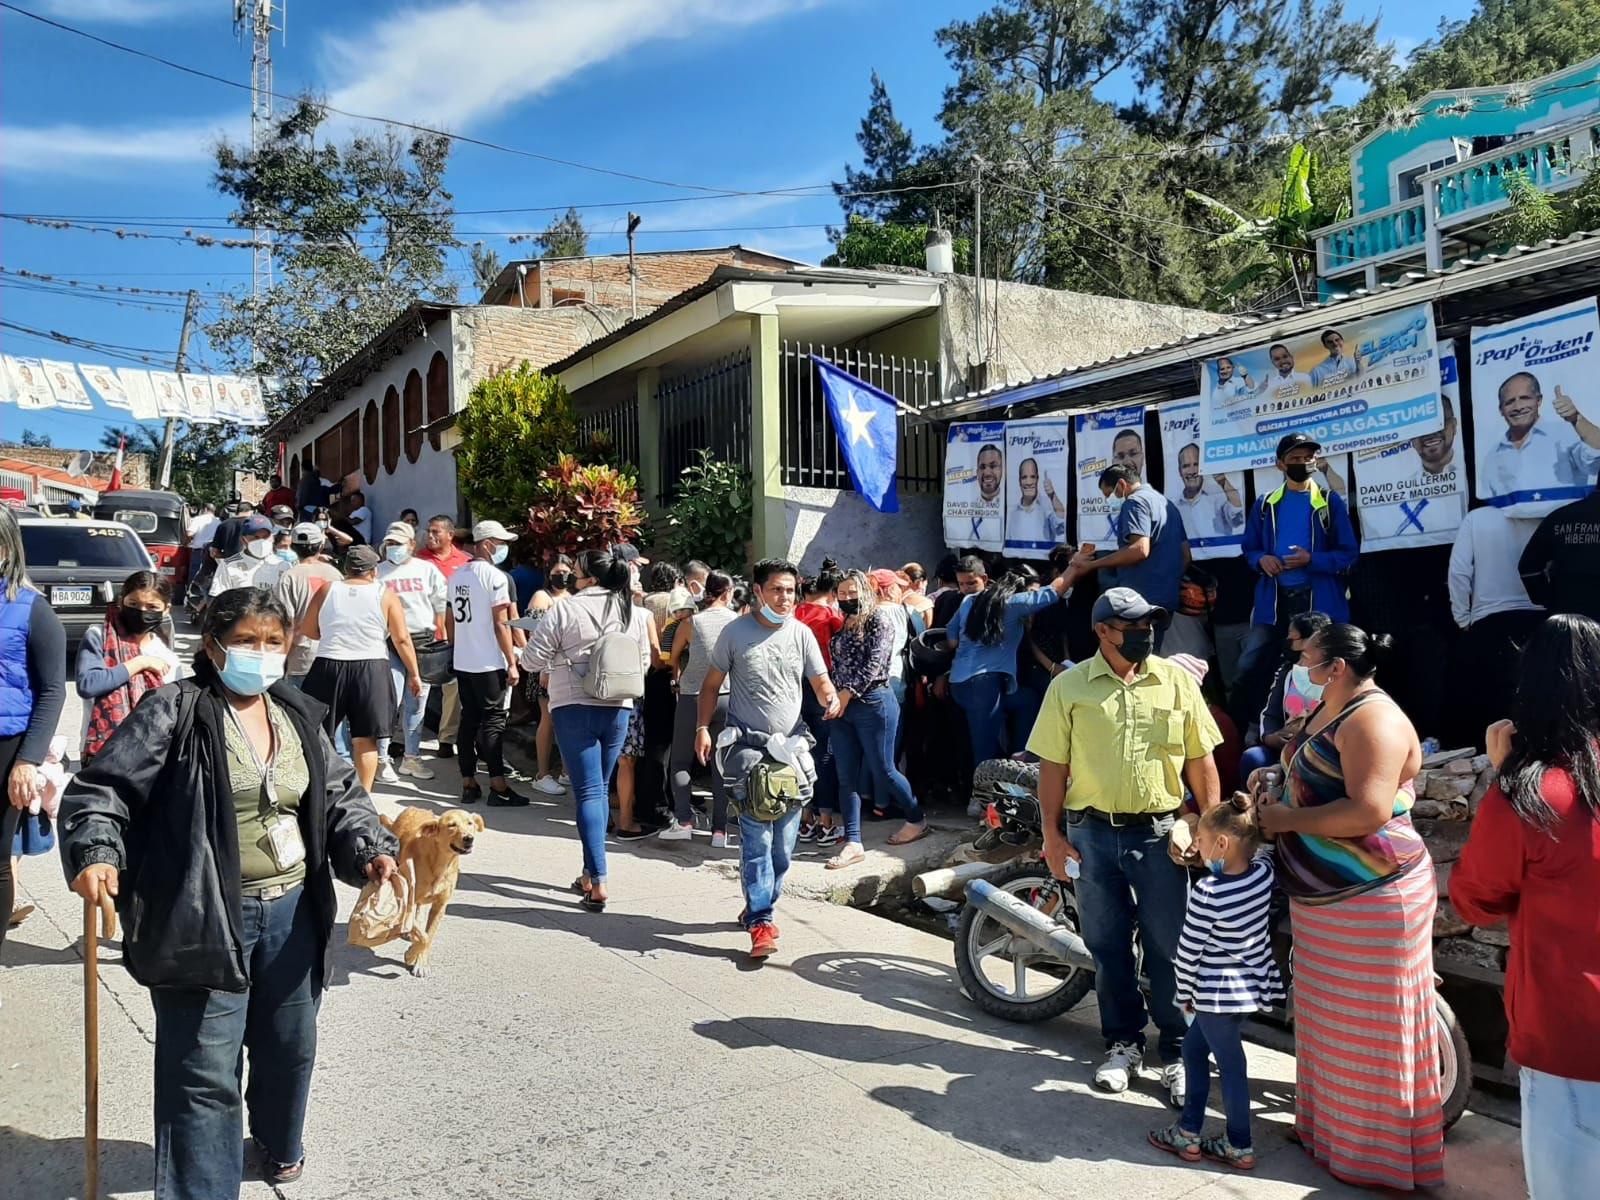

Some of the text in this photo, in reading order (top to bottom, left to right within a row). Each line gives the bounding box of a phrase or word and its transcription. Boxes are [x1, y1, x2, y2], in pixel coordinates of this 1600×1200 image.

[1524, 331, 1594, 359] Orden!
[1206, 445, 1233, 459] CEB
[1237, 427, 1328, 453] MAXIMNO
[1331, 401, 1435, 436] SAGASTUME
[1257, 403, 1365, 433] GRACIAS ESTRUCTURA DE LA
[1251, 458, 1269, 466] POR
[1332, 432, 1399, 451] COMPROMISO
[1360, 471, 1457, 495] DAVID GUILLERMO
[1409, 483, 1457, 499] MADISON
[1554, 523, 1572, 536] SAN
[1565, 533, 1600, 544] HIBERNI
